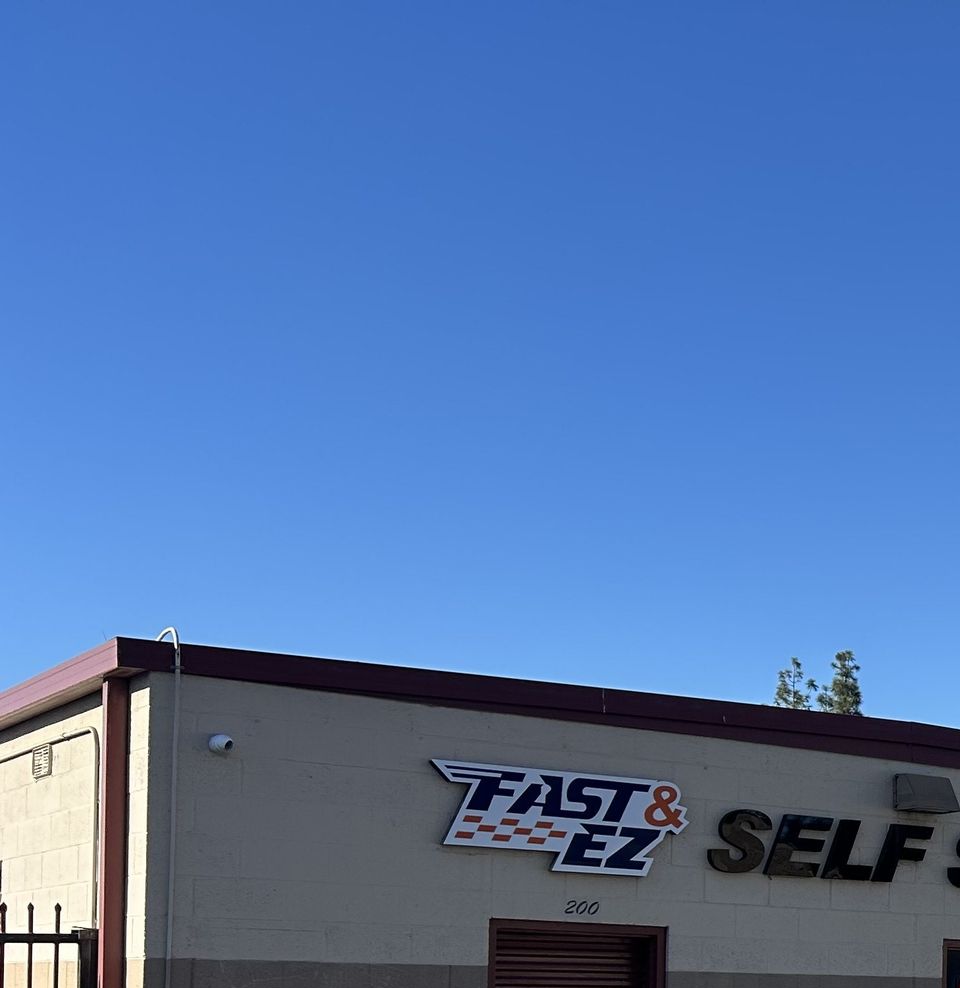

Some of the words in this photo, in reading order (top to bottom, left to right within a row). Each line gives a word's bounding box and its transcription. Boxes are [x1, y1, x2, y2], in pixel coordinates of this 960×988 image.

[446, 765, 651, 822] FAST
[644, 785, 683, 829] &
[561, 823, 661, 870] EZ
[707, 808, 934, 882] SELF
[565, 900, 600, 915] 200
